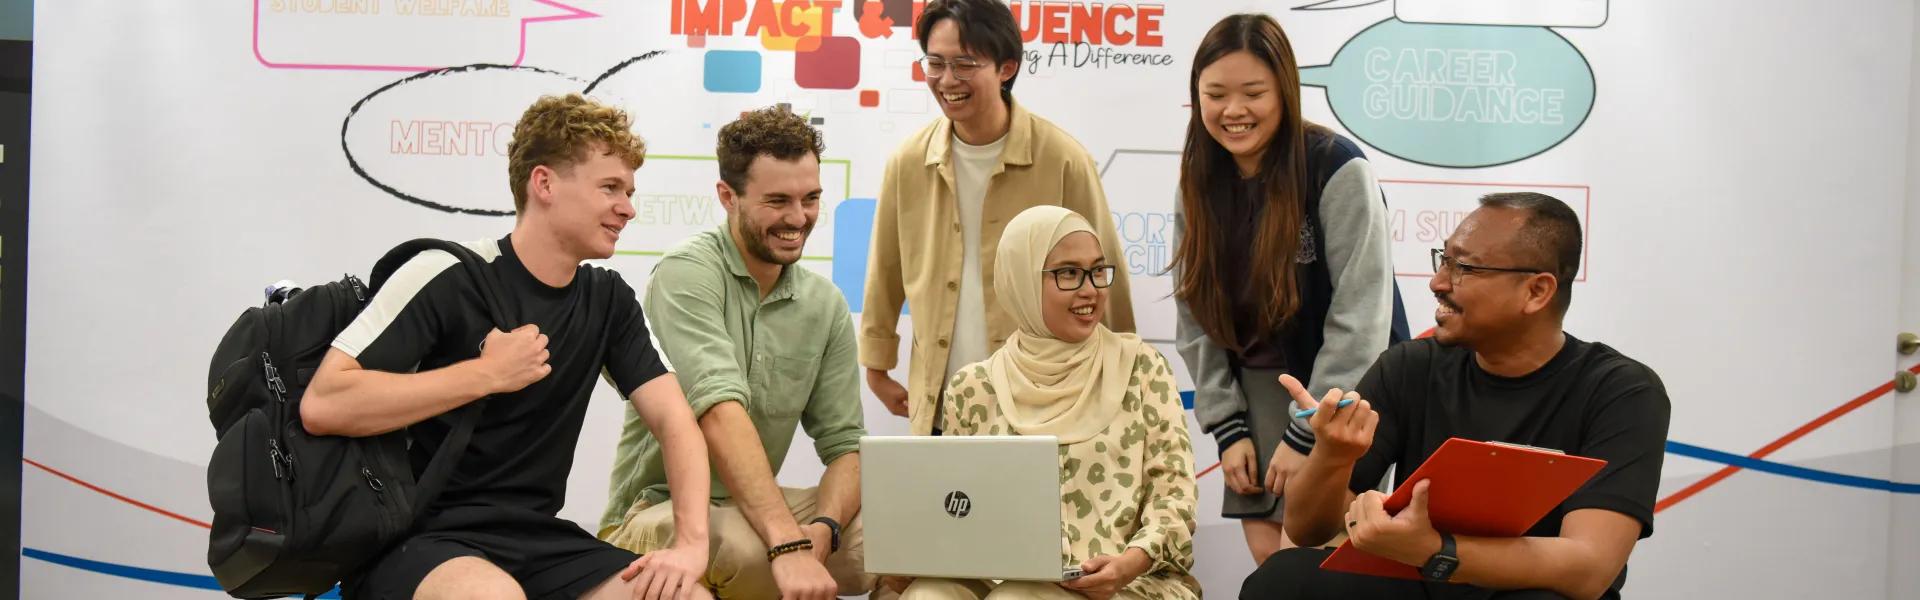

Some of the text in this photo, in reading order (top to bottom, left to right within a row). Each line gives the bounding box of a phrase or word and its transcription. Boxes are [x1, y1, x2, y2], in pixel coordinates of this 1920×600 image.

[394, 0, 511, 17] WELFARE
[670, 0, 842, 38] IMPACT
[858, 0, 895, 39] &
[1048, 40, 1068, 67] A
[1073, 41, 1174, 69] Difference
[1364, 47, 1517, 87] CAREER
[1362, 83, 1565, 125] GUIDANCE
[390, 119, 516, 156] MENTO
[947, 490, 970, 518] hp
